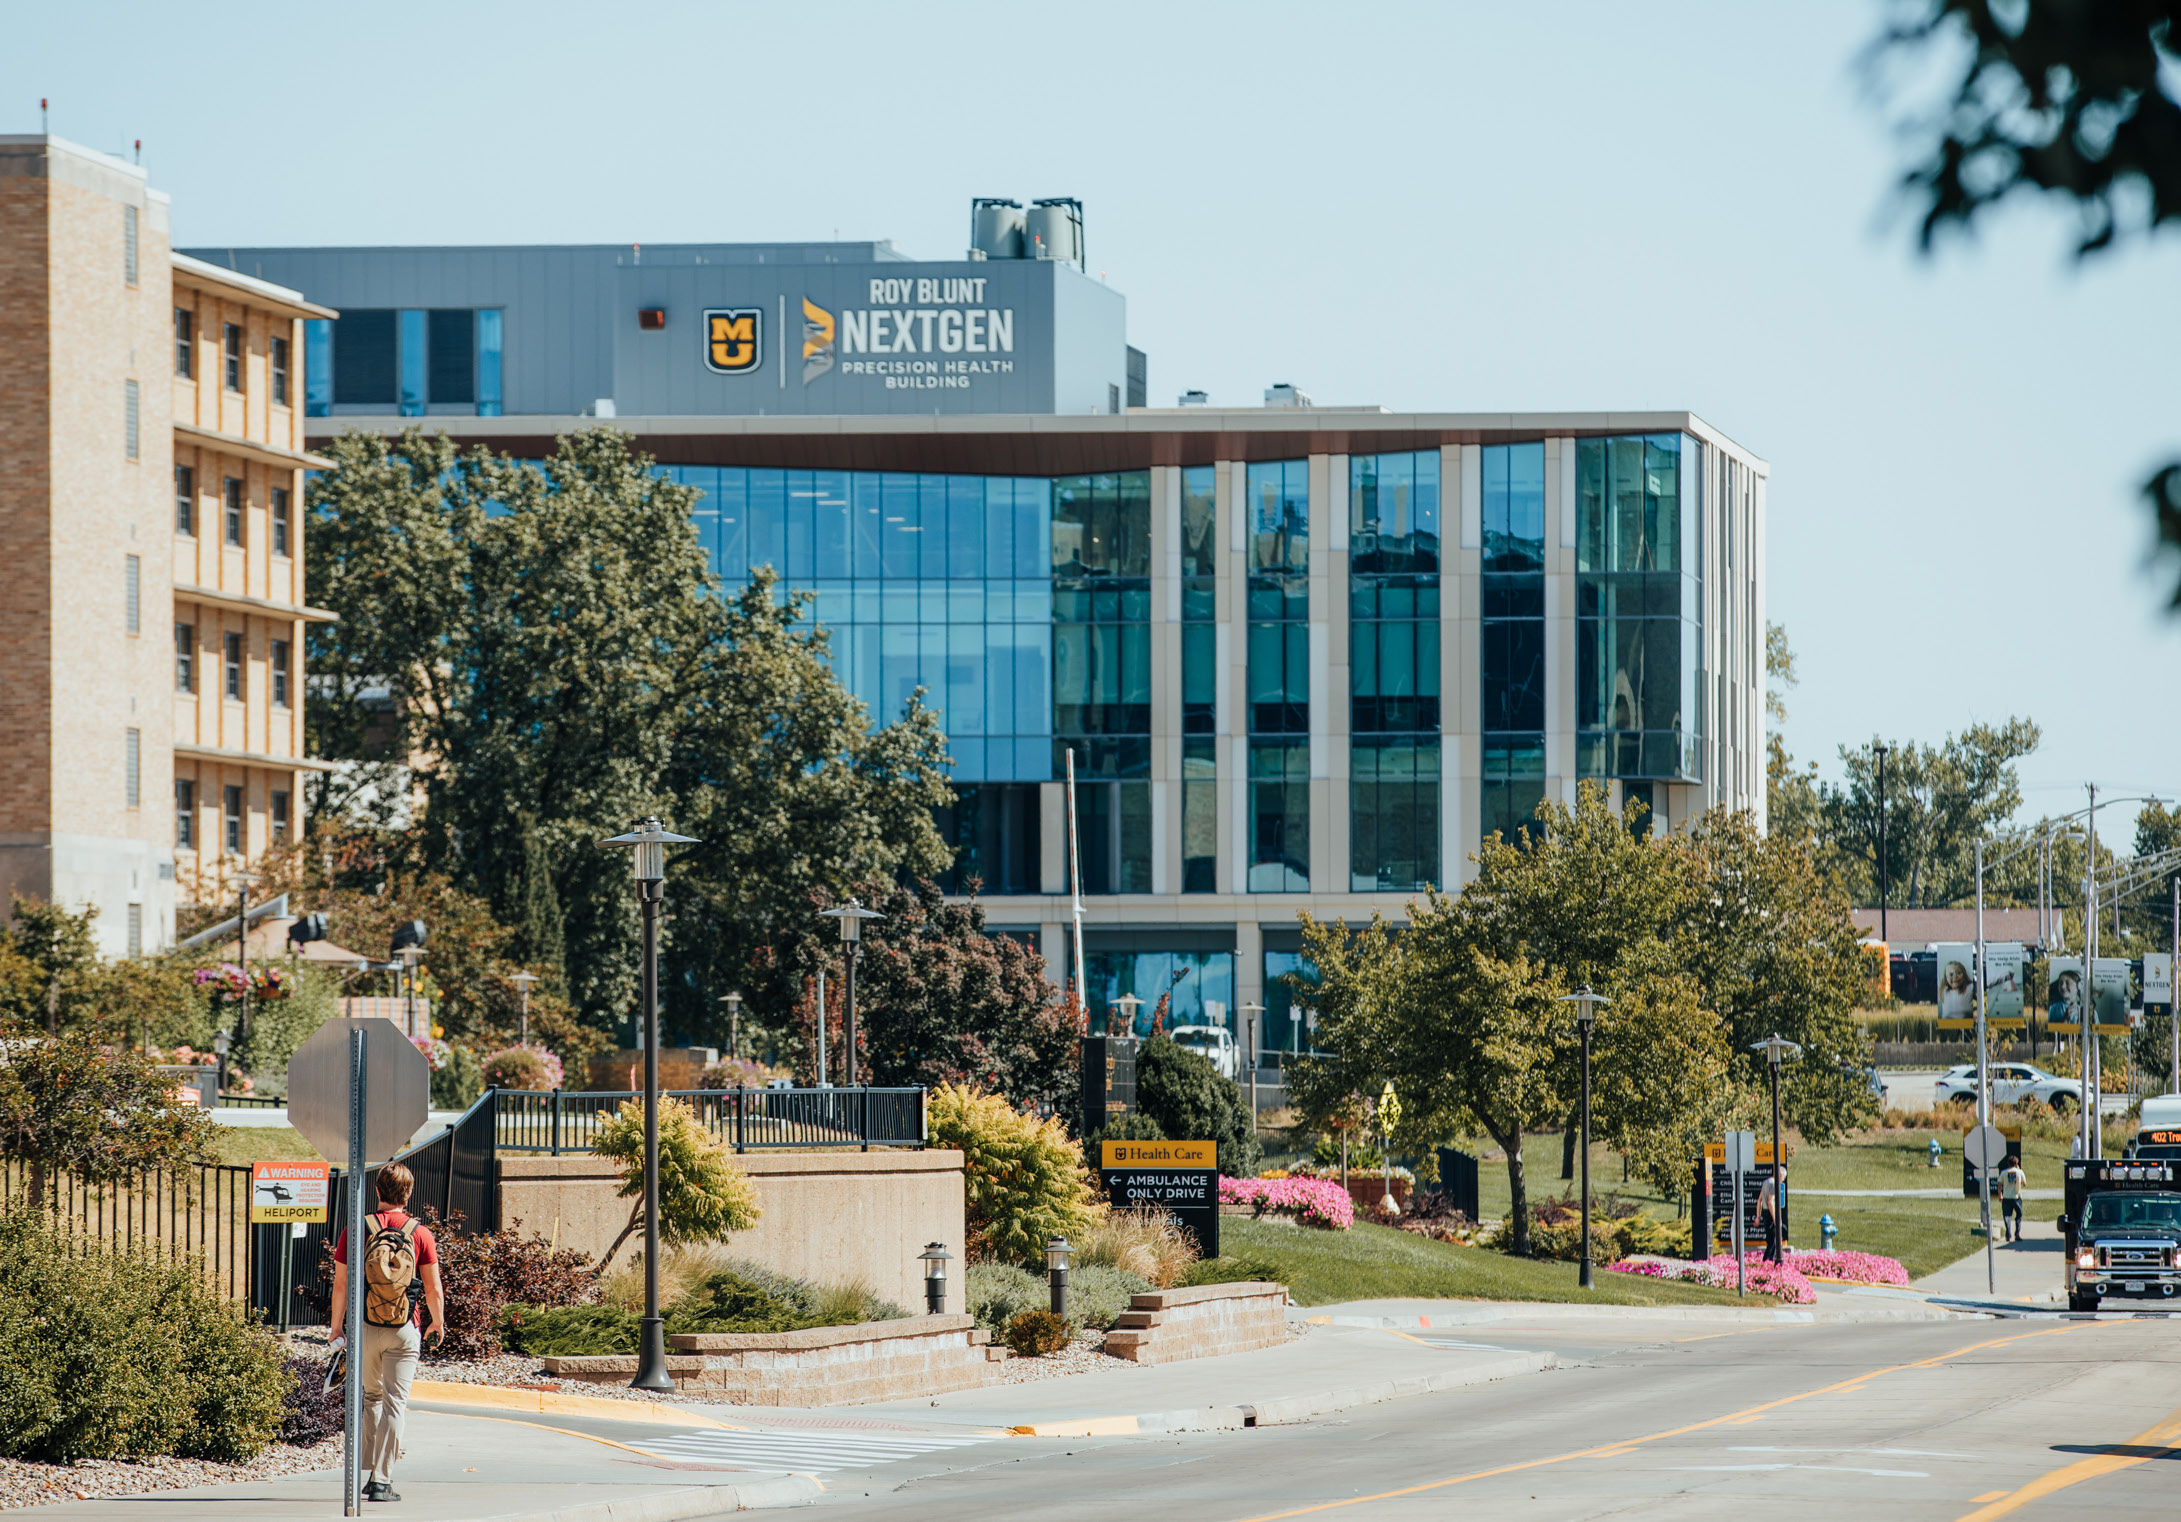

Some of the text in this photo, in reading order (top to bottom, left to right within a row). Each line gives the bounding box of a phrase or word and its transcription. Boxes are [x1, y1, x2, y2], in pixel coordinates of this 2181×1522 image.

[870, 278, 987, 304] ROY BLUNT
[842, 309, 1014, 353] NEXTGEN
[842, 360, 1014, 374] PRECISION HEALTH
[885, 375, 971, 389] BUILDING
[2152, 1131, 2167, 1143] 402
[1130, 1147, 1170, 1160] Health
[1174, 1147, 1203, 1160] Care
[270, 1168, 324, 1178] WARNING
[1126, 1175, 1208, 1186] AMBULANCE
[1126, 1188, 1206, 1199] ONLY DRIVE
[264, 1208, 319, 1217] HELIPORT
